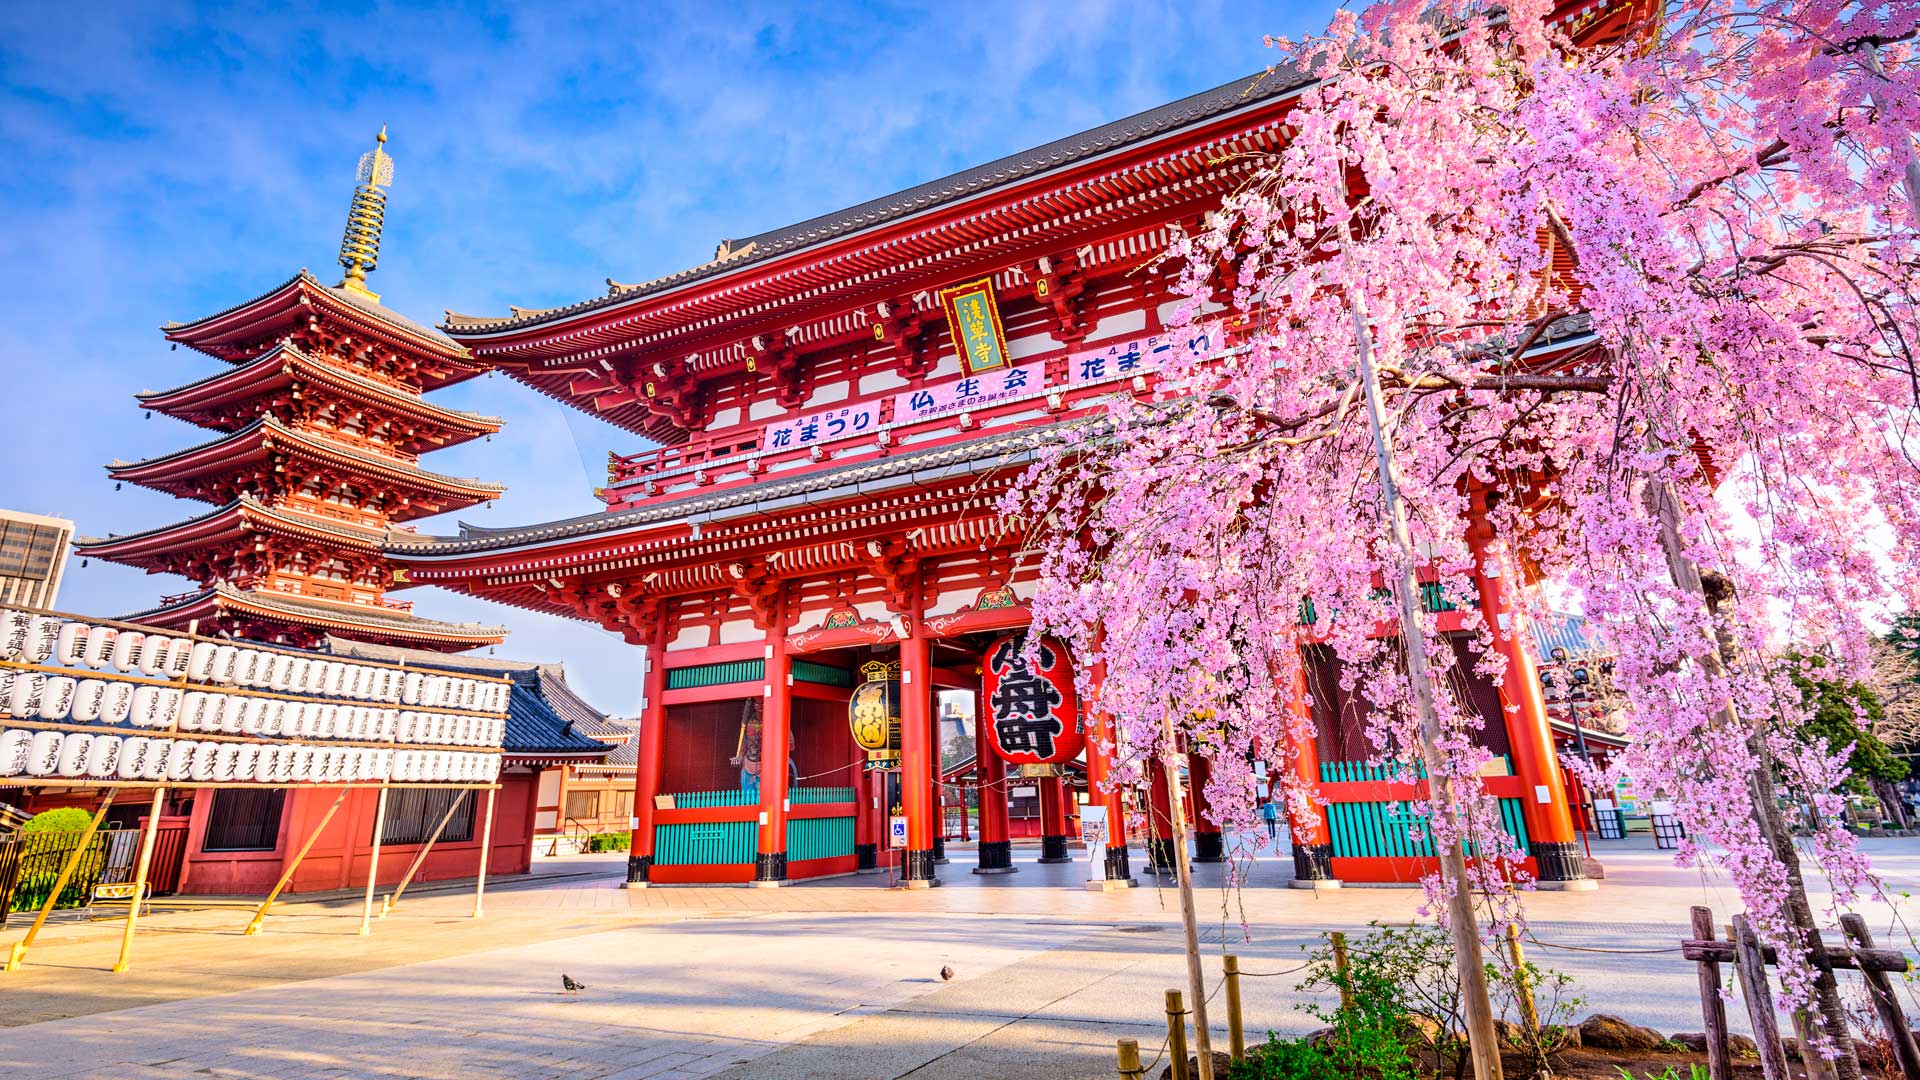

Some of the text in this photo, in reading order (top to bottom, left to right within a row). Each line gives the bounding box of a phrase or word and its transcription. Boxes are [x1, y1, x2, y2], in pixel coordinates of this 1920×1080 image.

[909, 368, 1029, 411] 仏生会
[772, 411, 870, 448] 花まつり
[795, 409, 849, 427] 4月8日
